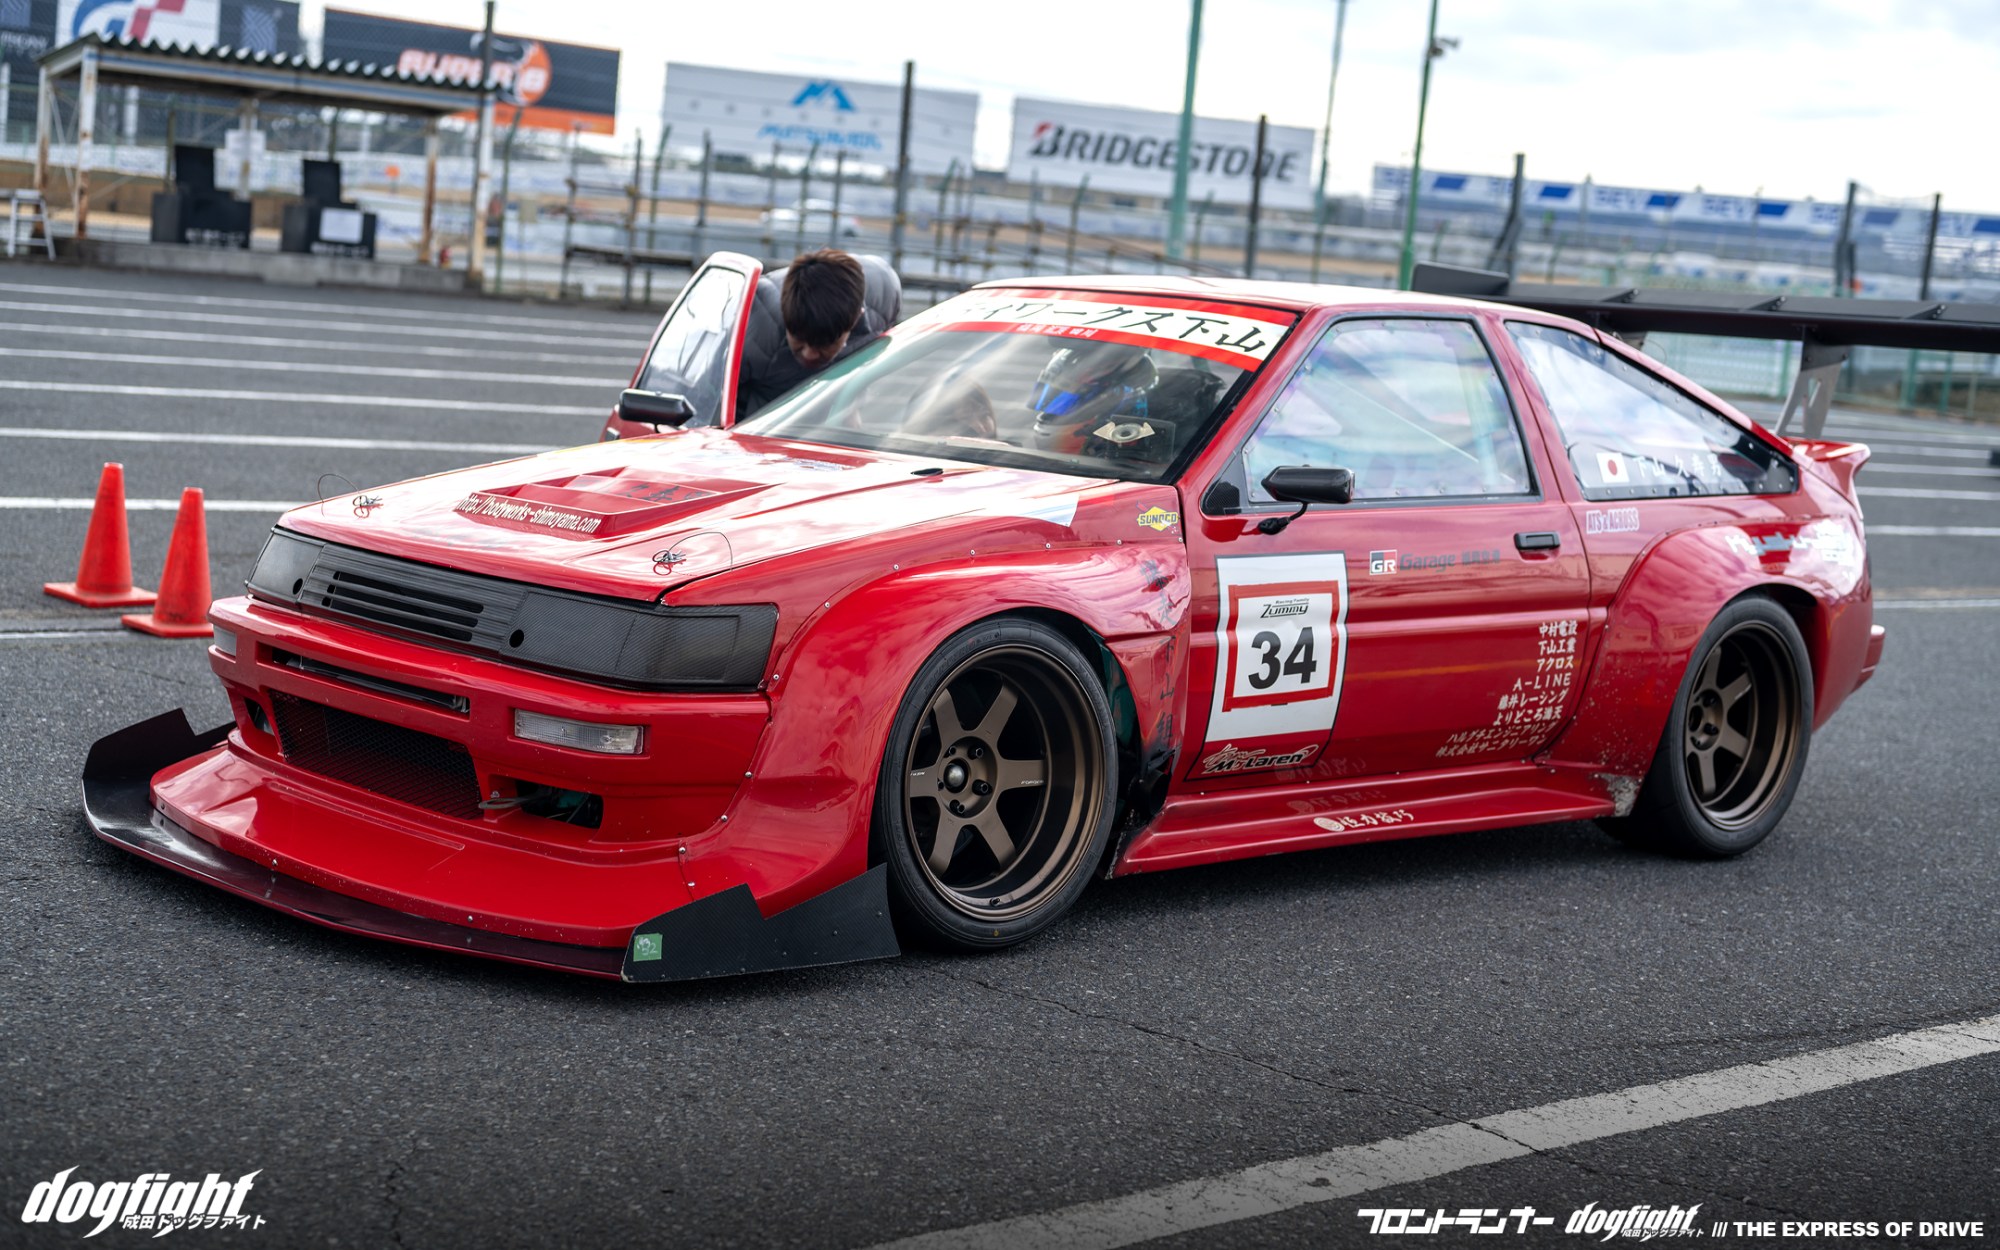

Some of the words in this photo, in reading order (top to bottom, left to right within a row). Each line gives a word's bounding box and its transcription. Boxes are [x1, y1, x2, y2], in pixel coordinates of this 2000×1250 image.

[1139, 513, 1178, 525] SUNOCO
[1371, 559, 1396, 573] GR
[1400, 552, 1457, 573] Garage
[1260, 603, 1309, 618] Zummy
[1248, 627, 1317, 690] 34
[1536, 655, 1574, 673] アクロス
[1512, 672, 1572, 692] A-LINE
